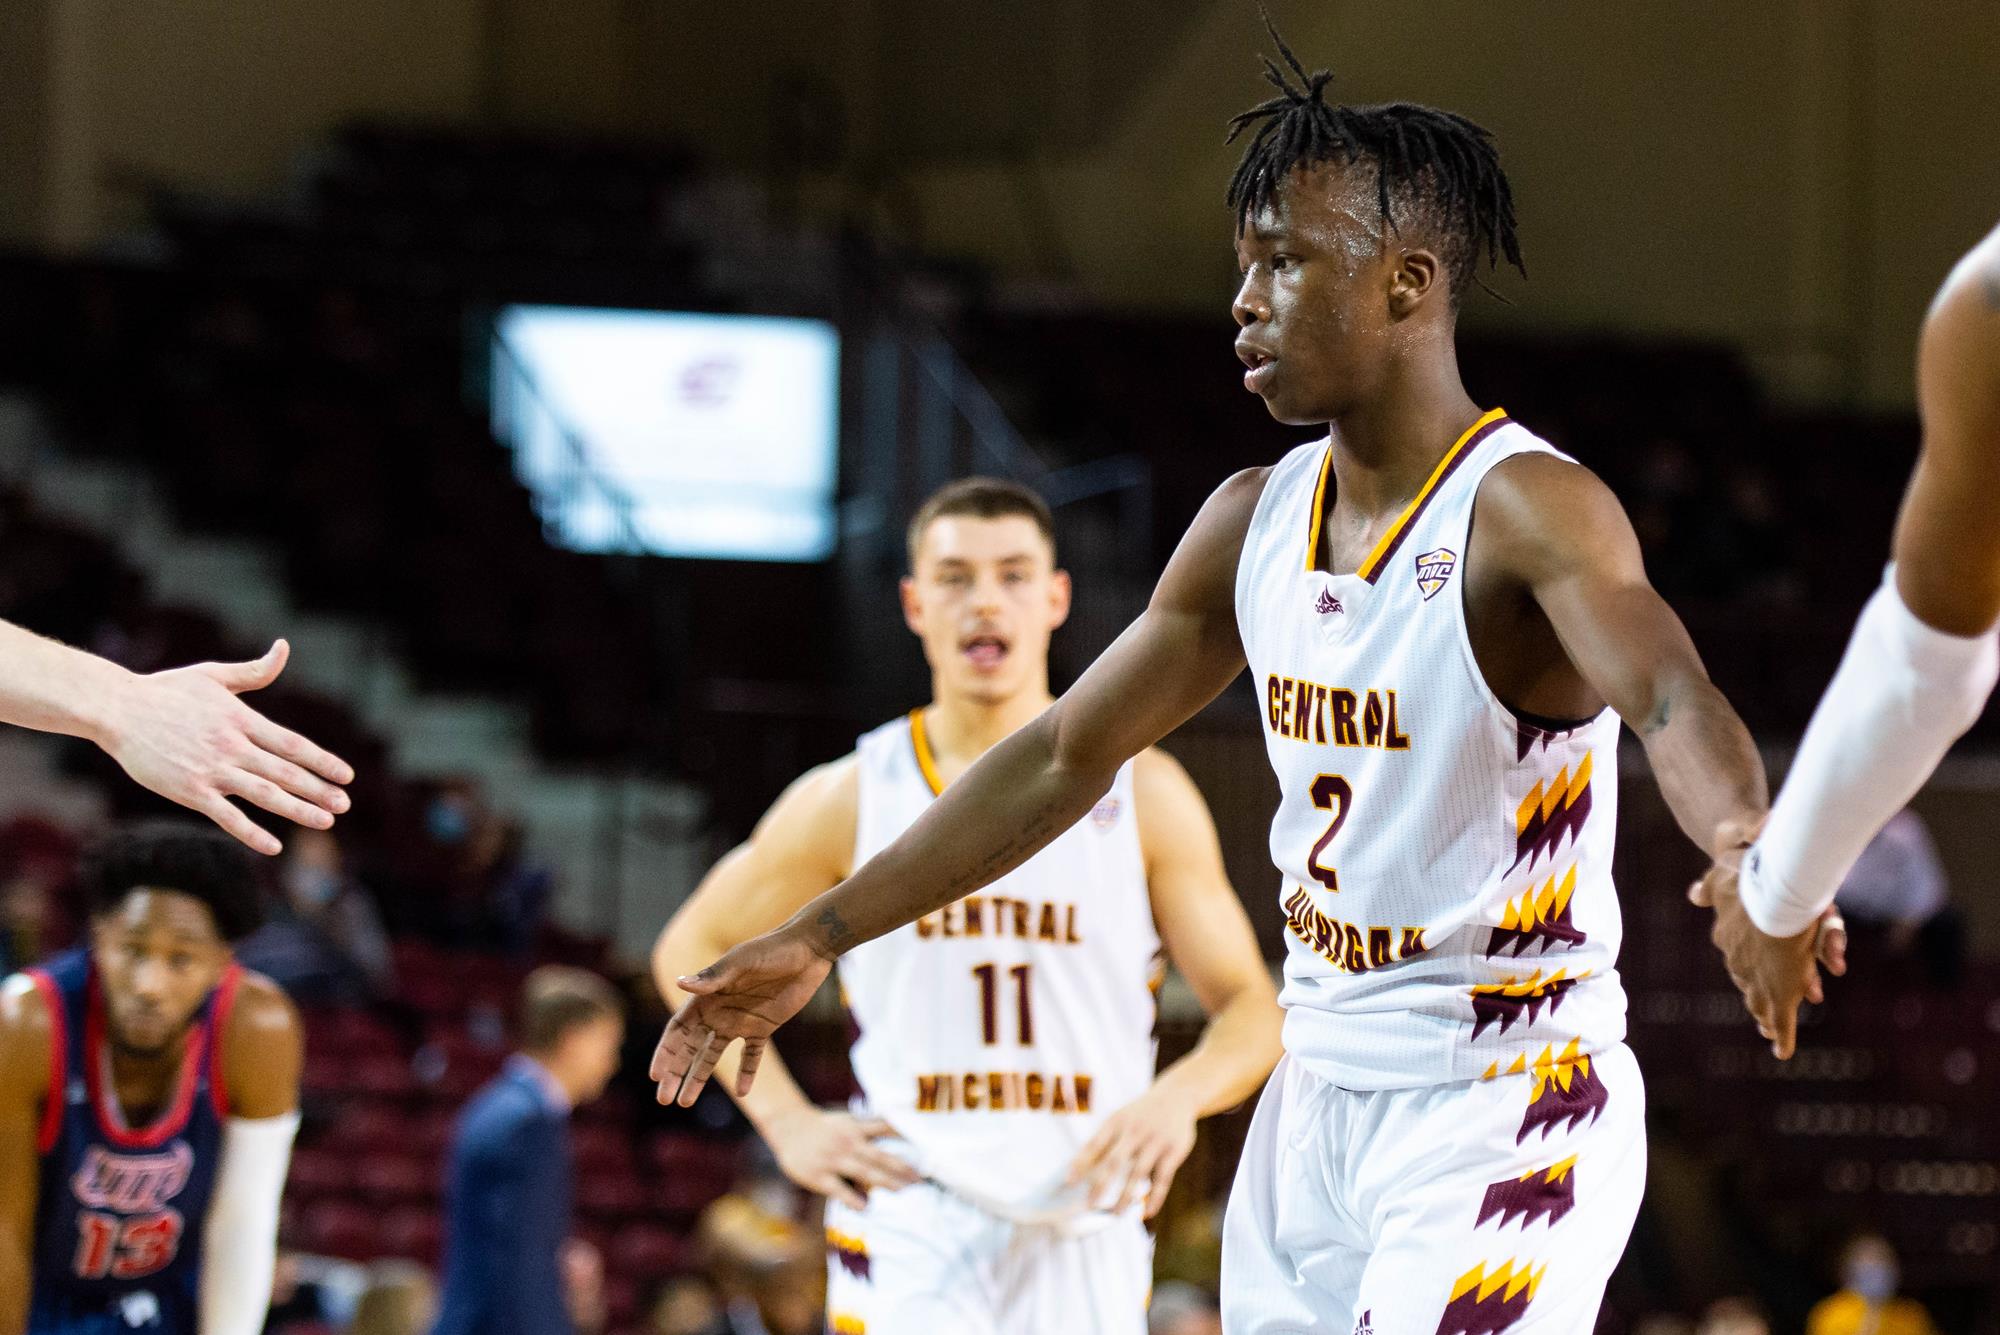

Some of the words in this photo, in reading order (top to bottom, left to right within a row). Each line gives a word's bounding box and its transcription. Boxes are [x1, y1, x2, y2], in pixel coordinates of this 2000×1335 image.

[1267, 673, 1411, 751] CENTRAL
[1307, 772, 1353, 893] 2
[972, 962, 1036, 1046] 11
[916, 1071, 1093, 1113] MICHIGAN
[76, 1209, 183, 1279] 13
